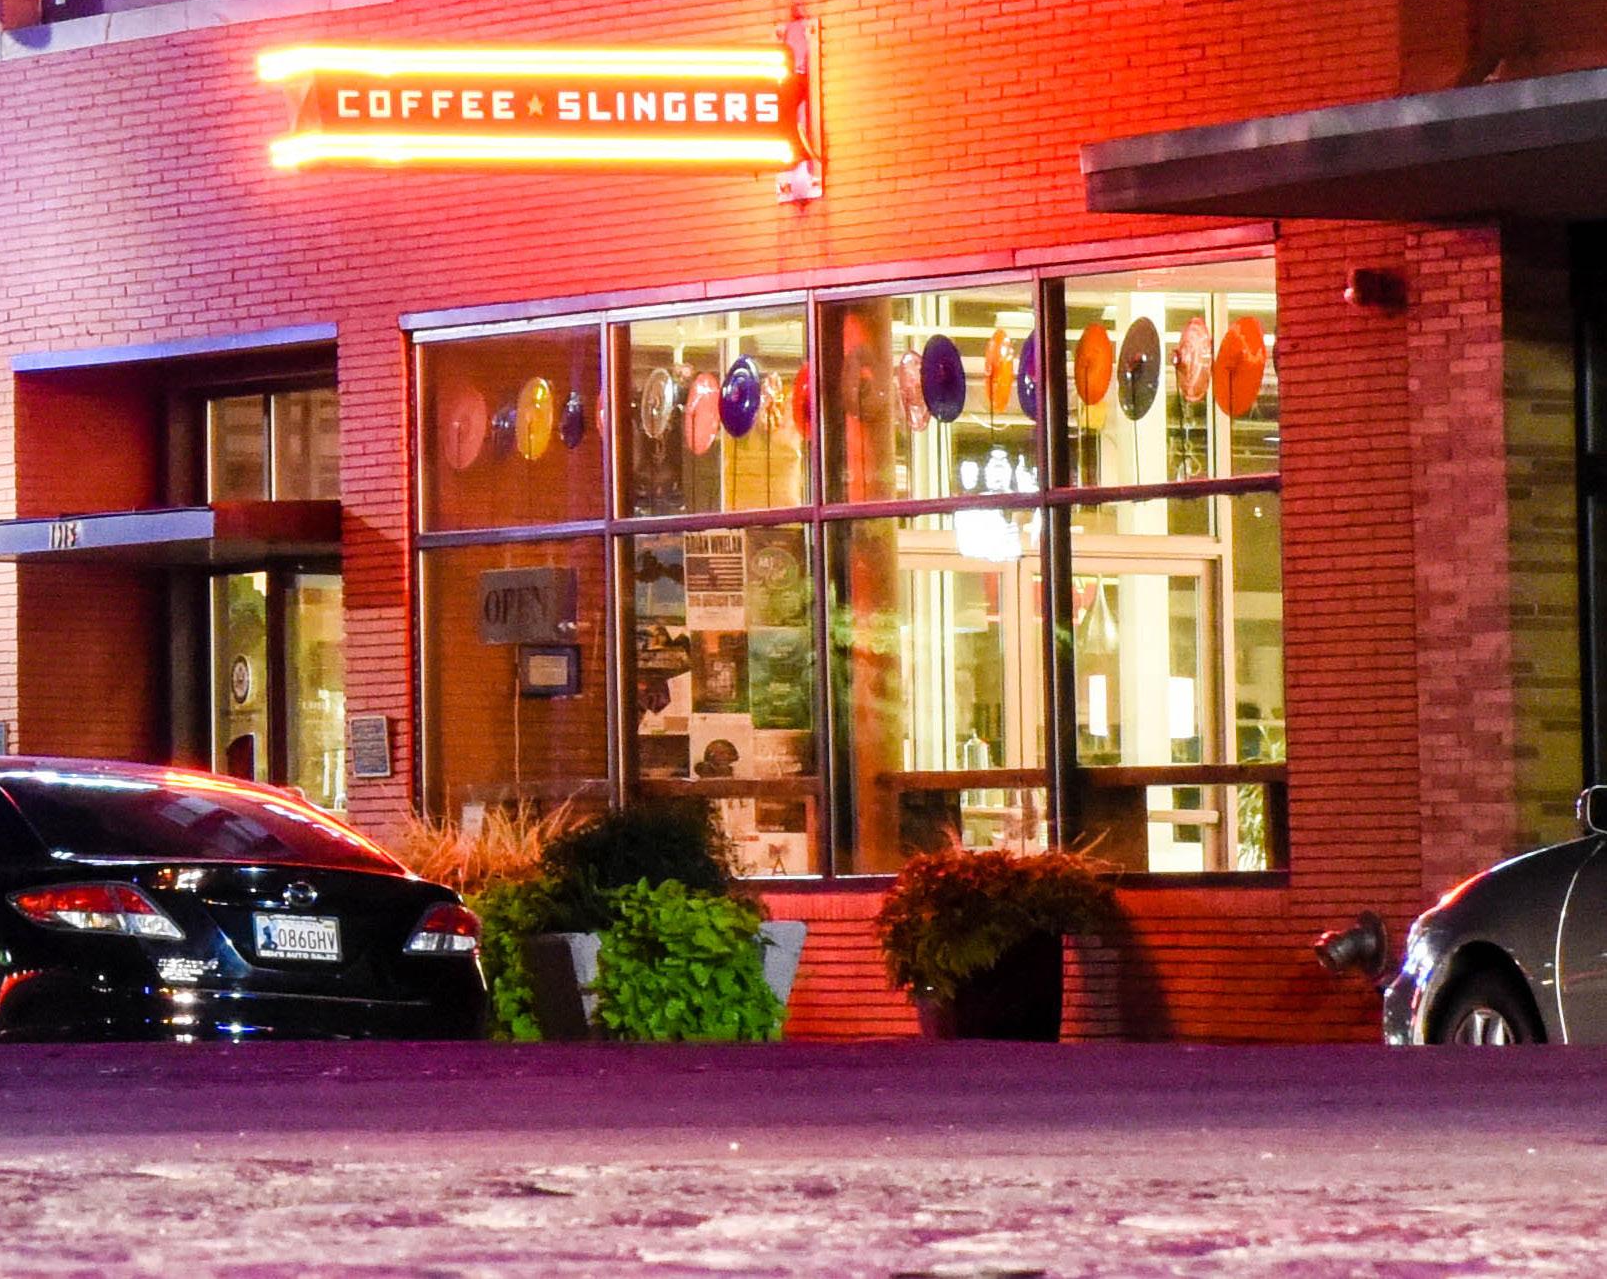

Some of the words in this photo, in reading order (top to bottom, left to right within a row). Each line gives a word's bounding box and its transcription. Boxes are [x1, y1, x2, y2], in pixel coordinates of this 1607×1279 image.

[337, 89, 515, 119] COFFEE
[558, 91, 779, 123] SLINGERS
[278, 929, 335, 950] 086GHV
